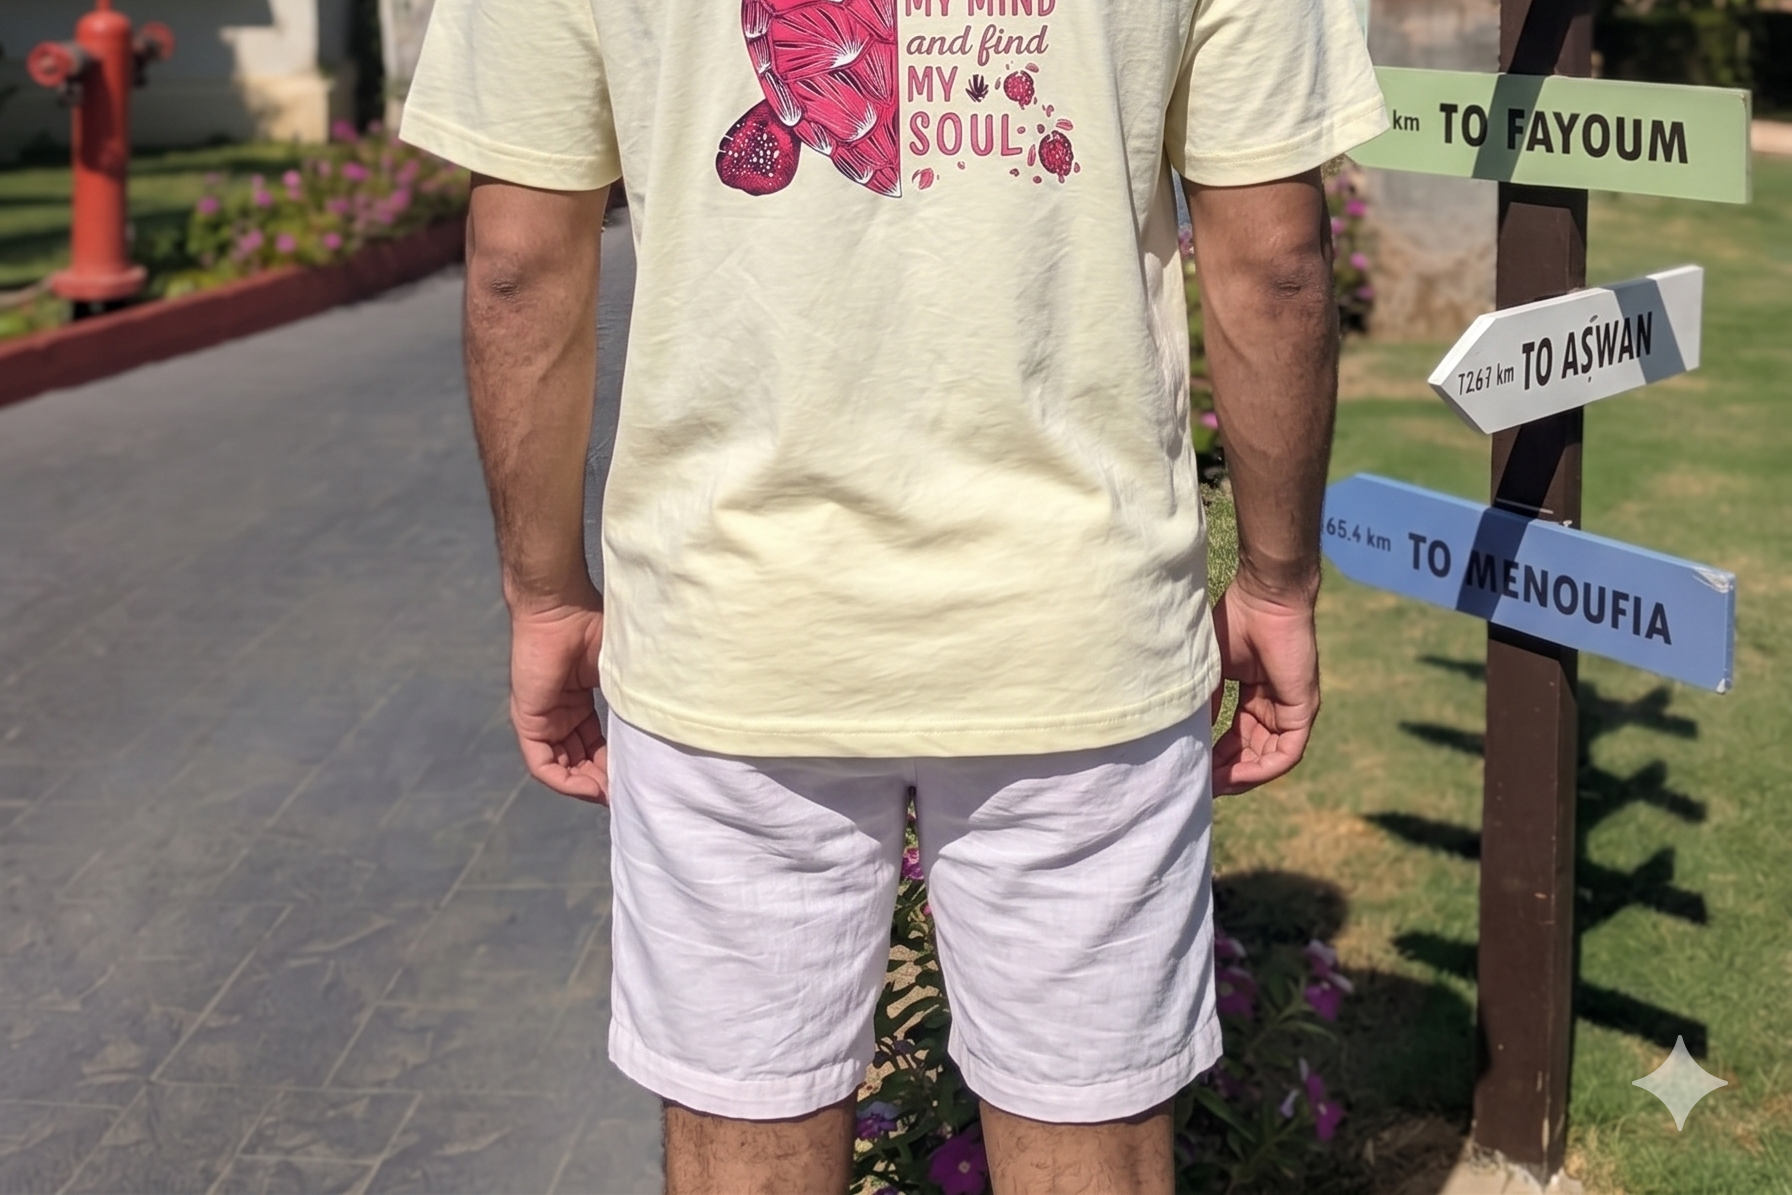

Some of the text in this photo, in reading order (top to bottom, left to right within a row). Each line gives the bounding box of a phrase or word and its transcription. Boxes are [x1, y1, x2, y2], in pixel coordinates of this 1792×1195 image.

[905, 23, 1049, 67] and find
[907, 65, 959, 103] MY
[908, 110, 1023, 157] SOUL
[1392, 102, 1689, 164] km TO FAYOUM
[1496, 363, 1515, 386] km
[1521, 337, 1553, 391] TO
[1366, 527, 1391, 552] km
[1408, 532, 1452, 578] TO
[1465, 550, 1673, 645] MENOUFIA
